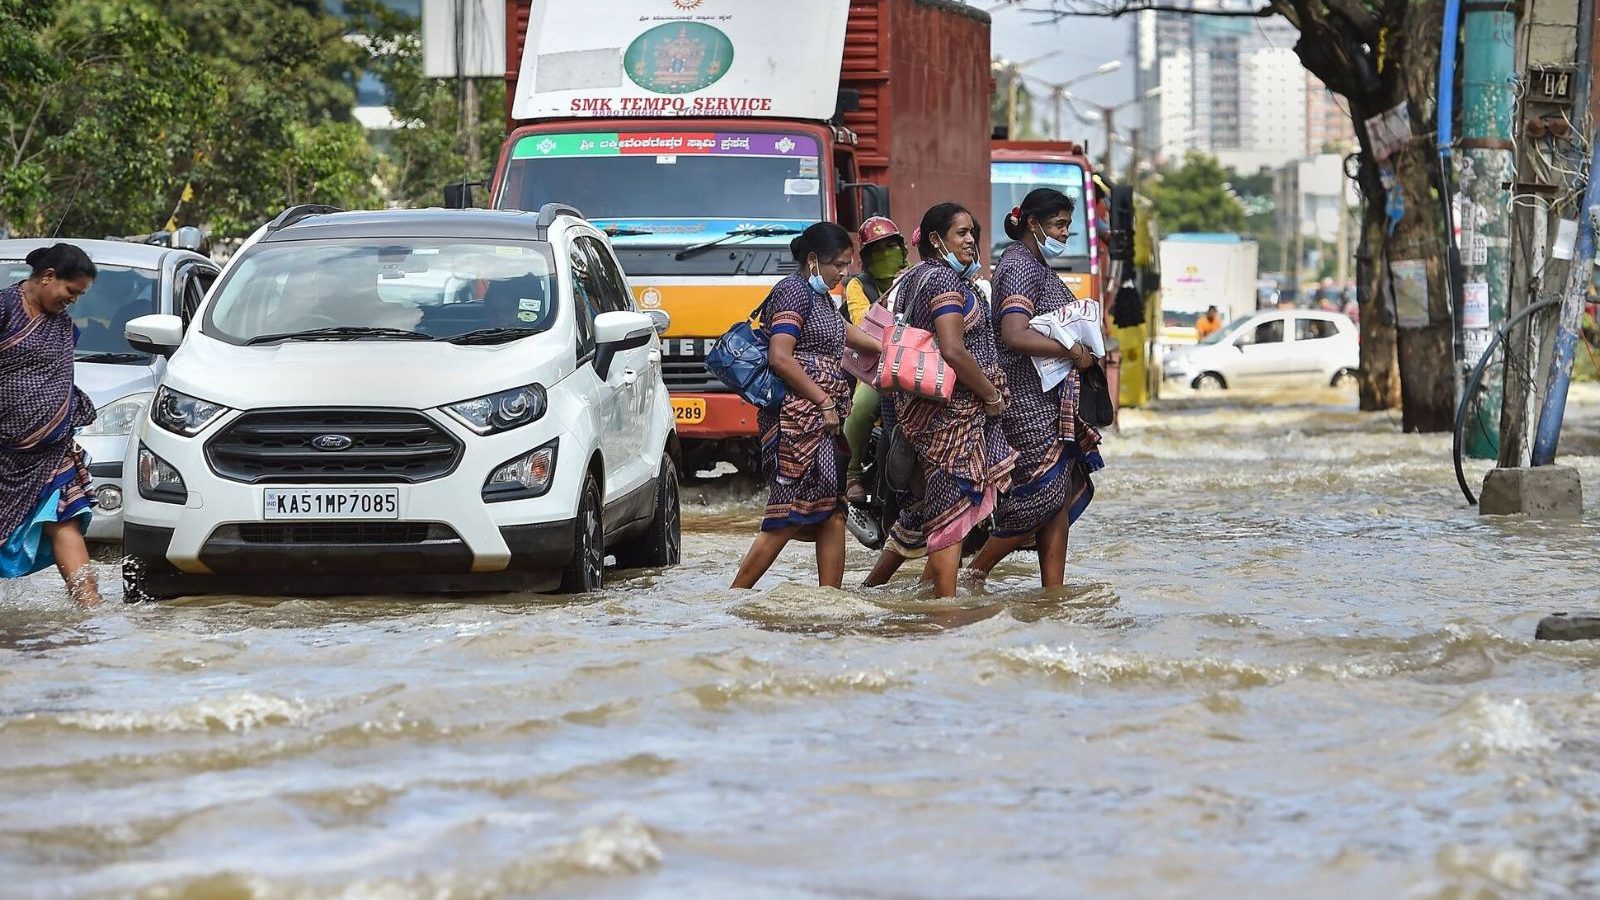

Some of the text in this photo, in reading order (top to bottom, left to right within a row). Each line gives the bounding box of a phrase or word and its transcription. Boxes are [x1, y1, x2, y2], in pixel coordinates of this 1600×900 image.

[570, 97, 771, 111] SMK TEMPO SERVICE
[579, 139, 595, 151] ಶ್ರೀ
[672, 407, 701, 419] 289
[320, 436, 342, 446] Ford
[277, 494, 396, 514] KA51MP7085
